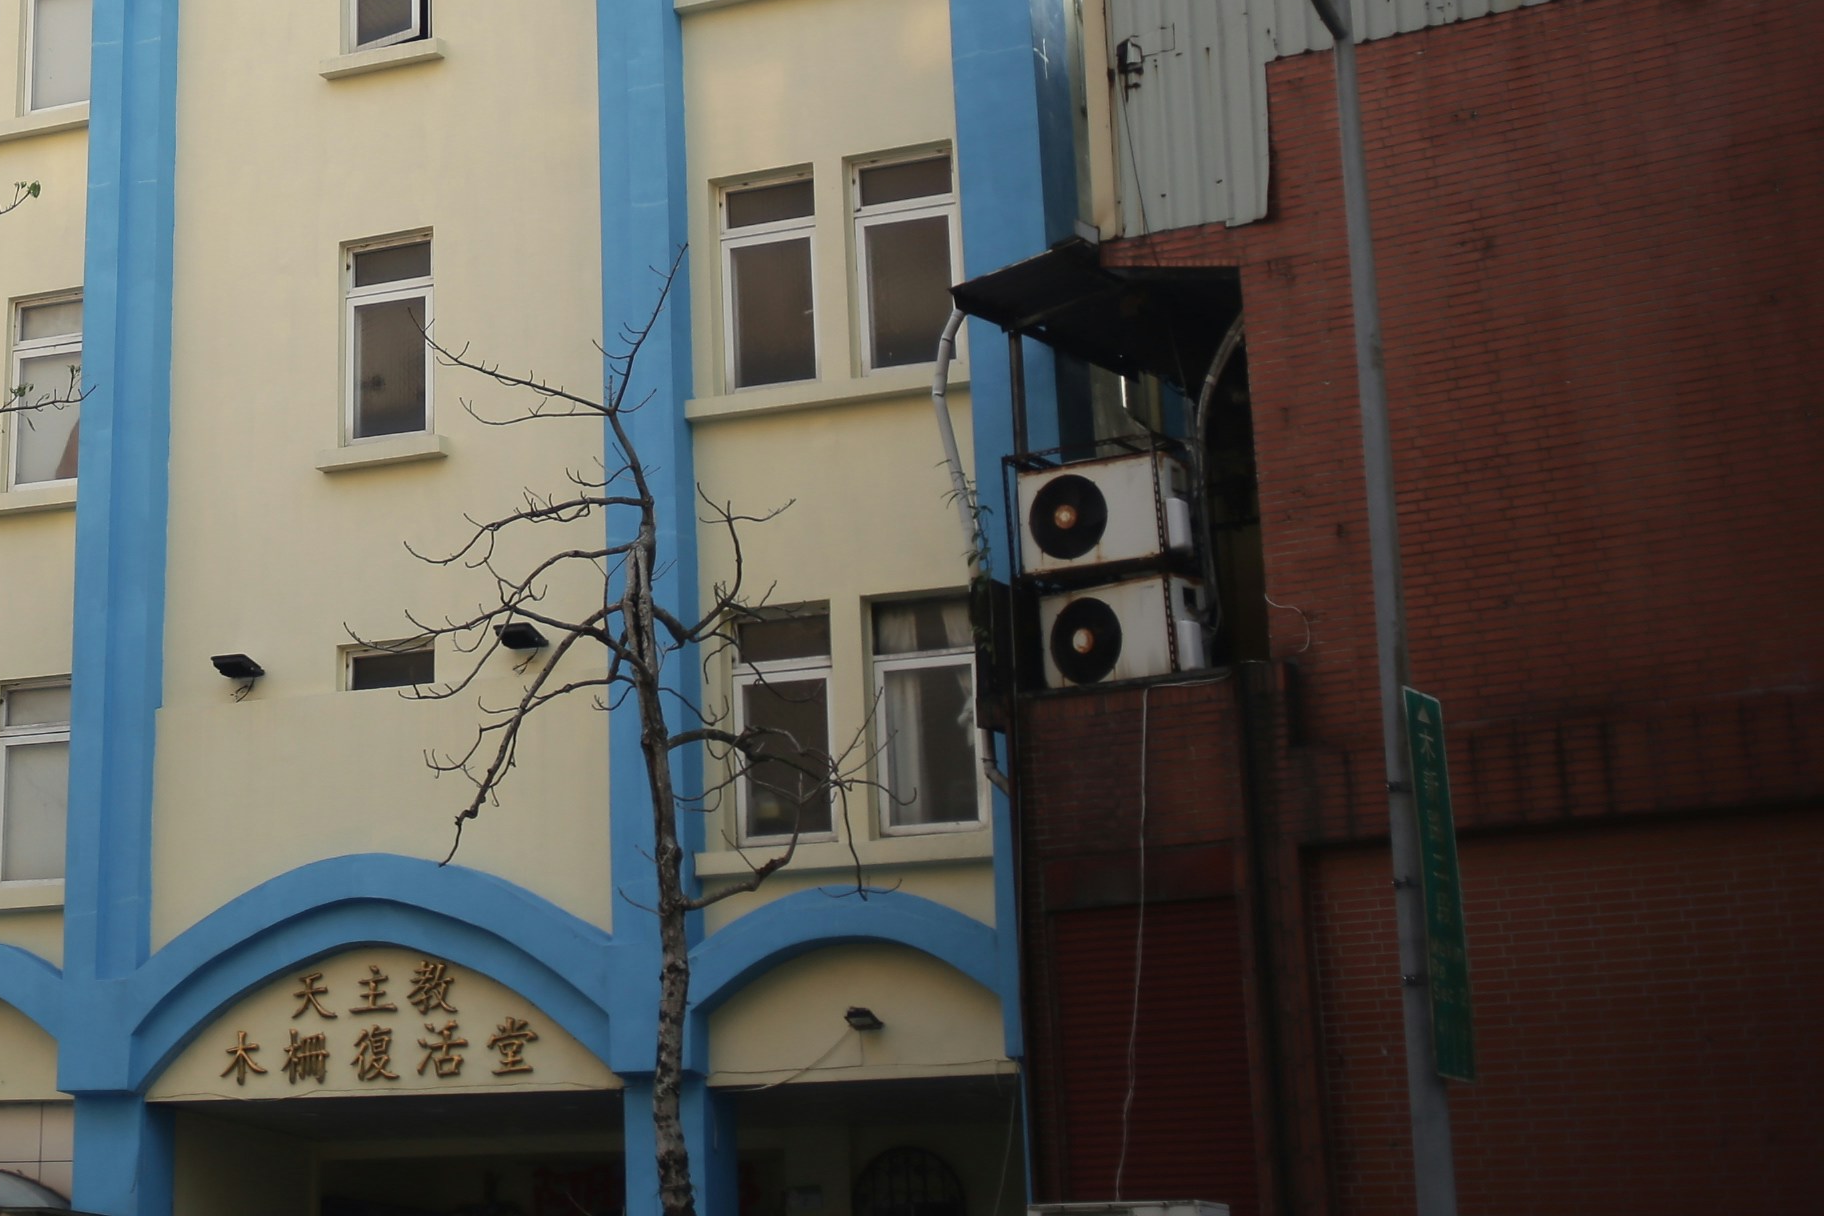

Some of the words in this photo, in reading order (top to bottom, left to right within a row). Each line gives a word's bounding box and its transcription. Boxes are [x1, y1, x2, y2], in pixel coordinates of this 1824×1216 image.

[291, 960, 459, 1021] 天主教
[219, 1016, 539, 1086] 木柵復活堂
